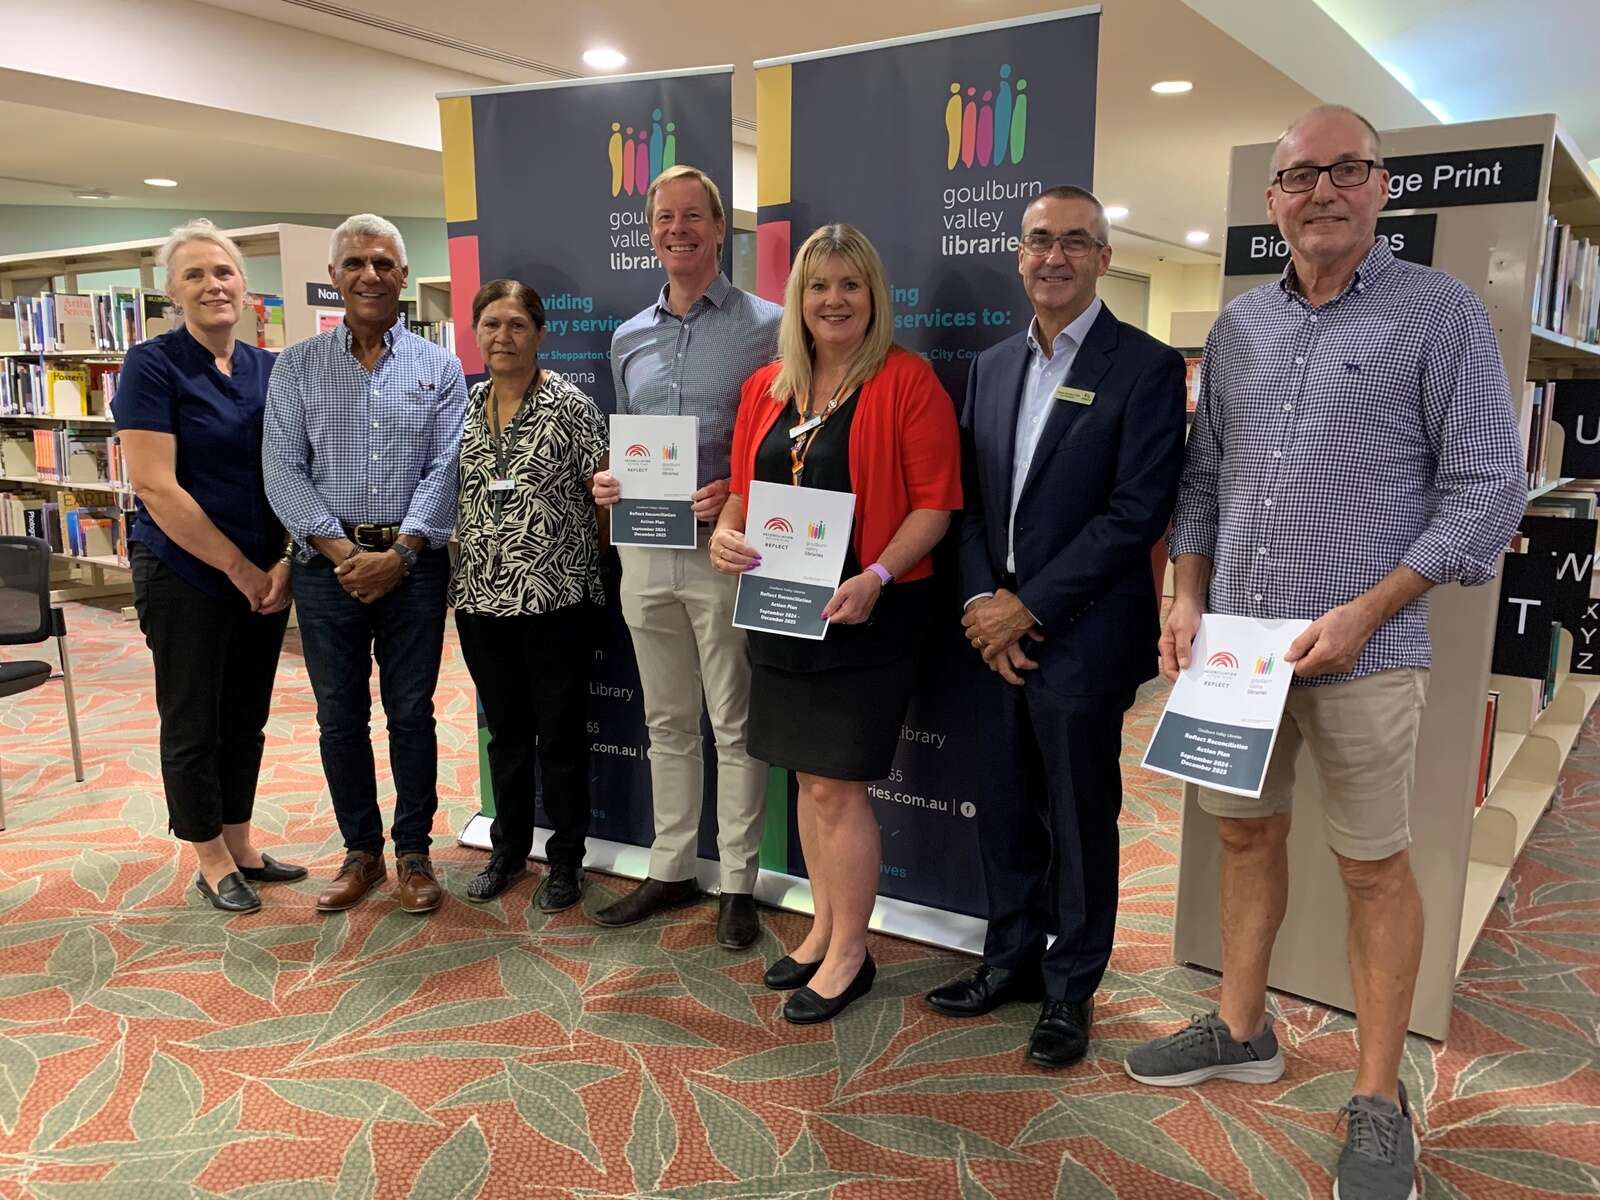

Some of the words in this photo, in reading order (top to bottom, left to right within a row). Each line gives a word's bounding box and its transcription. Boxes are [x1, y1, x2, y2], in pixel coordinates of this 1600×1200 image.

[1388, 174, 1423, 199] ge
[1433, 160, 1502, 190] Print
[943, 179, 1042, 209] goulburn
[943, 208, 1004, 232] valley
[610, 230, 655, 251] valle
[942, 232, 1020, 256] librarie
[318, 288, 339, 300] Non
[541, 293, 593, 313] viding
[890, 284, 920, 307] ing
[544, 319, 568, 336] ary
[572, 315, 622, 332] servic
[894, 308, 978, 329] services
[982, 308, 1010, 325] to:
[537, 351, 549, 360] ter
[551, 350, 604, 361] Shepparton
[930, 349, 954, 362] City
[1576, 414, 1600, 445] U
[764, 542, 789, 550] REFLECT
[1551, 552, 1592, 582] W
[1508, 597, 1541, 635] T
[1580, 602, 1600, 620] X
[1580, 627, 1597, 645] Y
[1577, 653, 1594, 669] Z
[589, 680, 634, 702] Library
[1204, 680, 1231, 689] REFLECT
[586, 721, 600, 734] 65
[898, 724, 946, 749] ibrary
[589, 742, 637, 757] .com.au
[1184, 732, 1206, 743] Reflect
[1206, 738, 1249, 750] Reconciliation
[1180, 751, 1213, 764] September
[1196, 746, 1217, 755] Action
[1216, 750, 1230, 758] Plan
[1180, 759, 1212, 771] December
[867, 784, 948, 812] ries.com.au
[879, 860, 907, 879] ives
